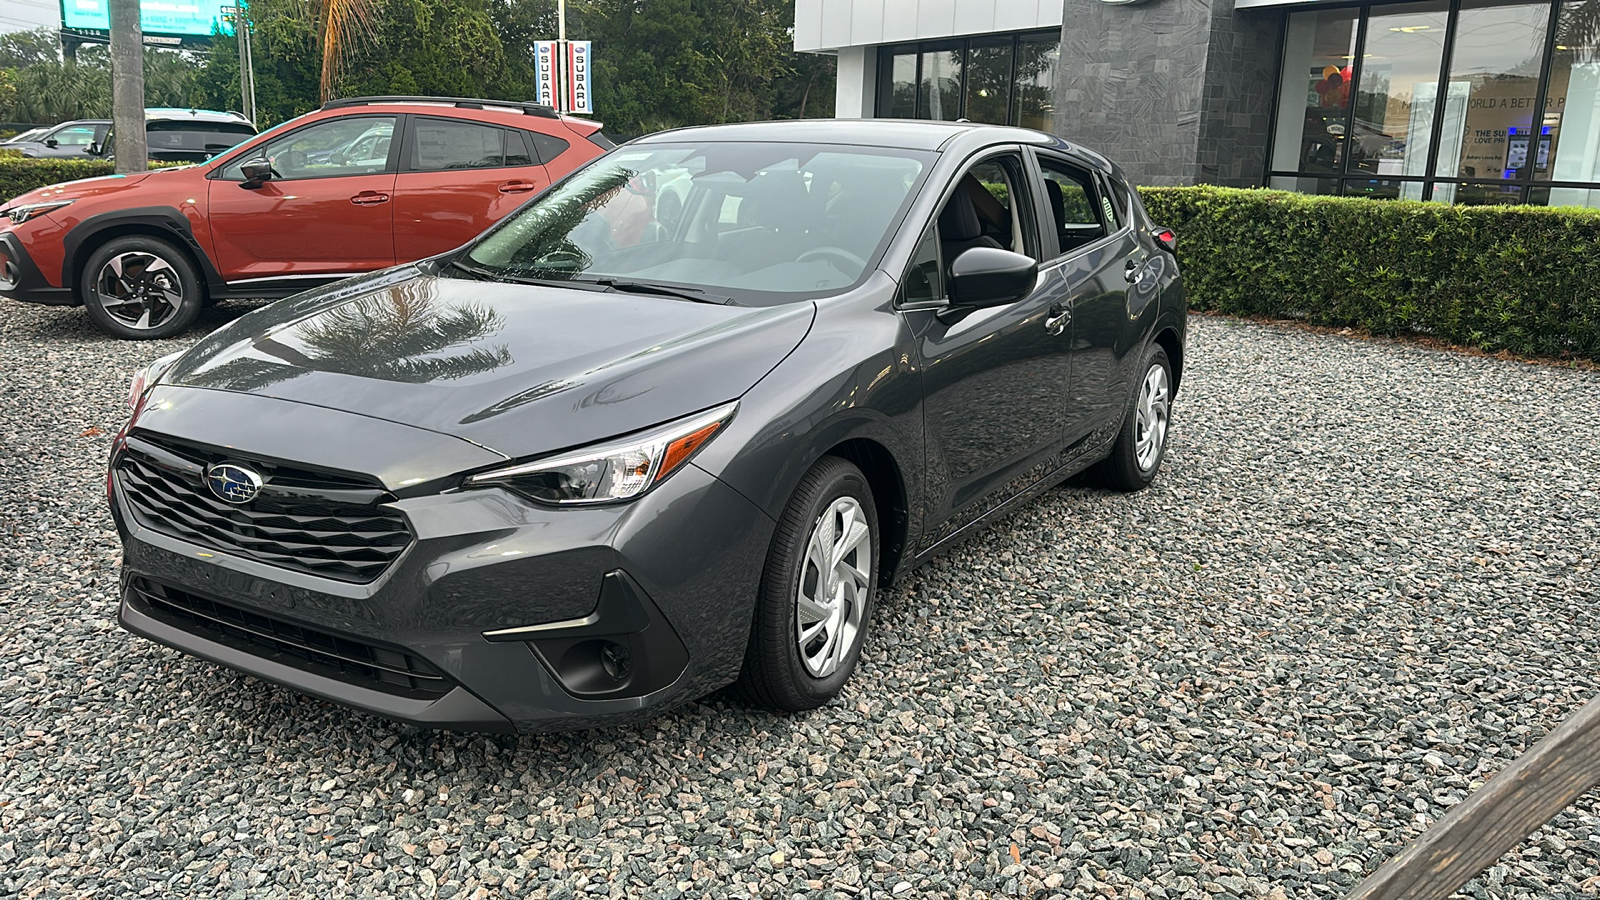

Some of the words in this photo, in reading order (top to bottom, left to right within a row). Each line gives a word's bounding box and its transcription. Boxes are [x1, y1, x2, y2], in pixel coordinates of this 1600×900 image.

[576, 56, 585, 108] SUBARU
[1468, 98, 1496, 108] ORLD
[1500, 98, 1507, 108] A
